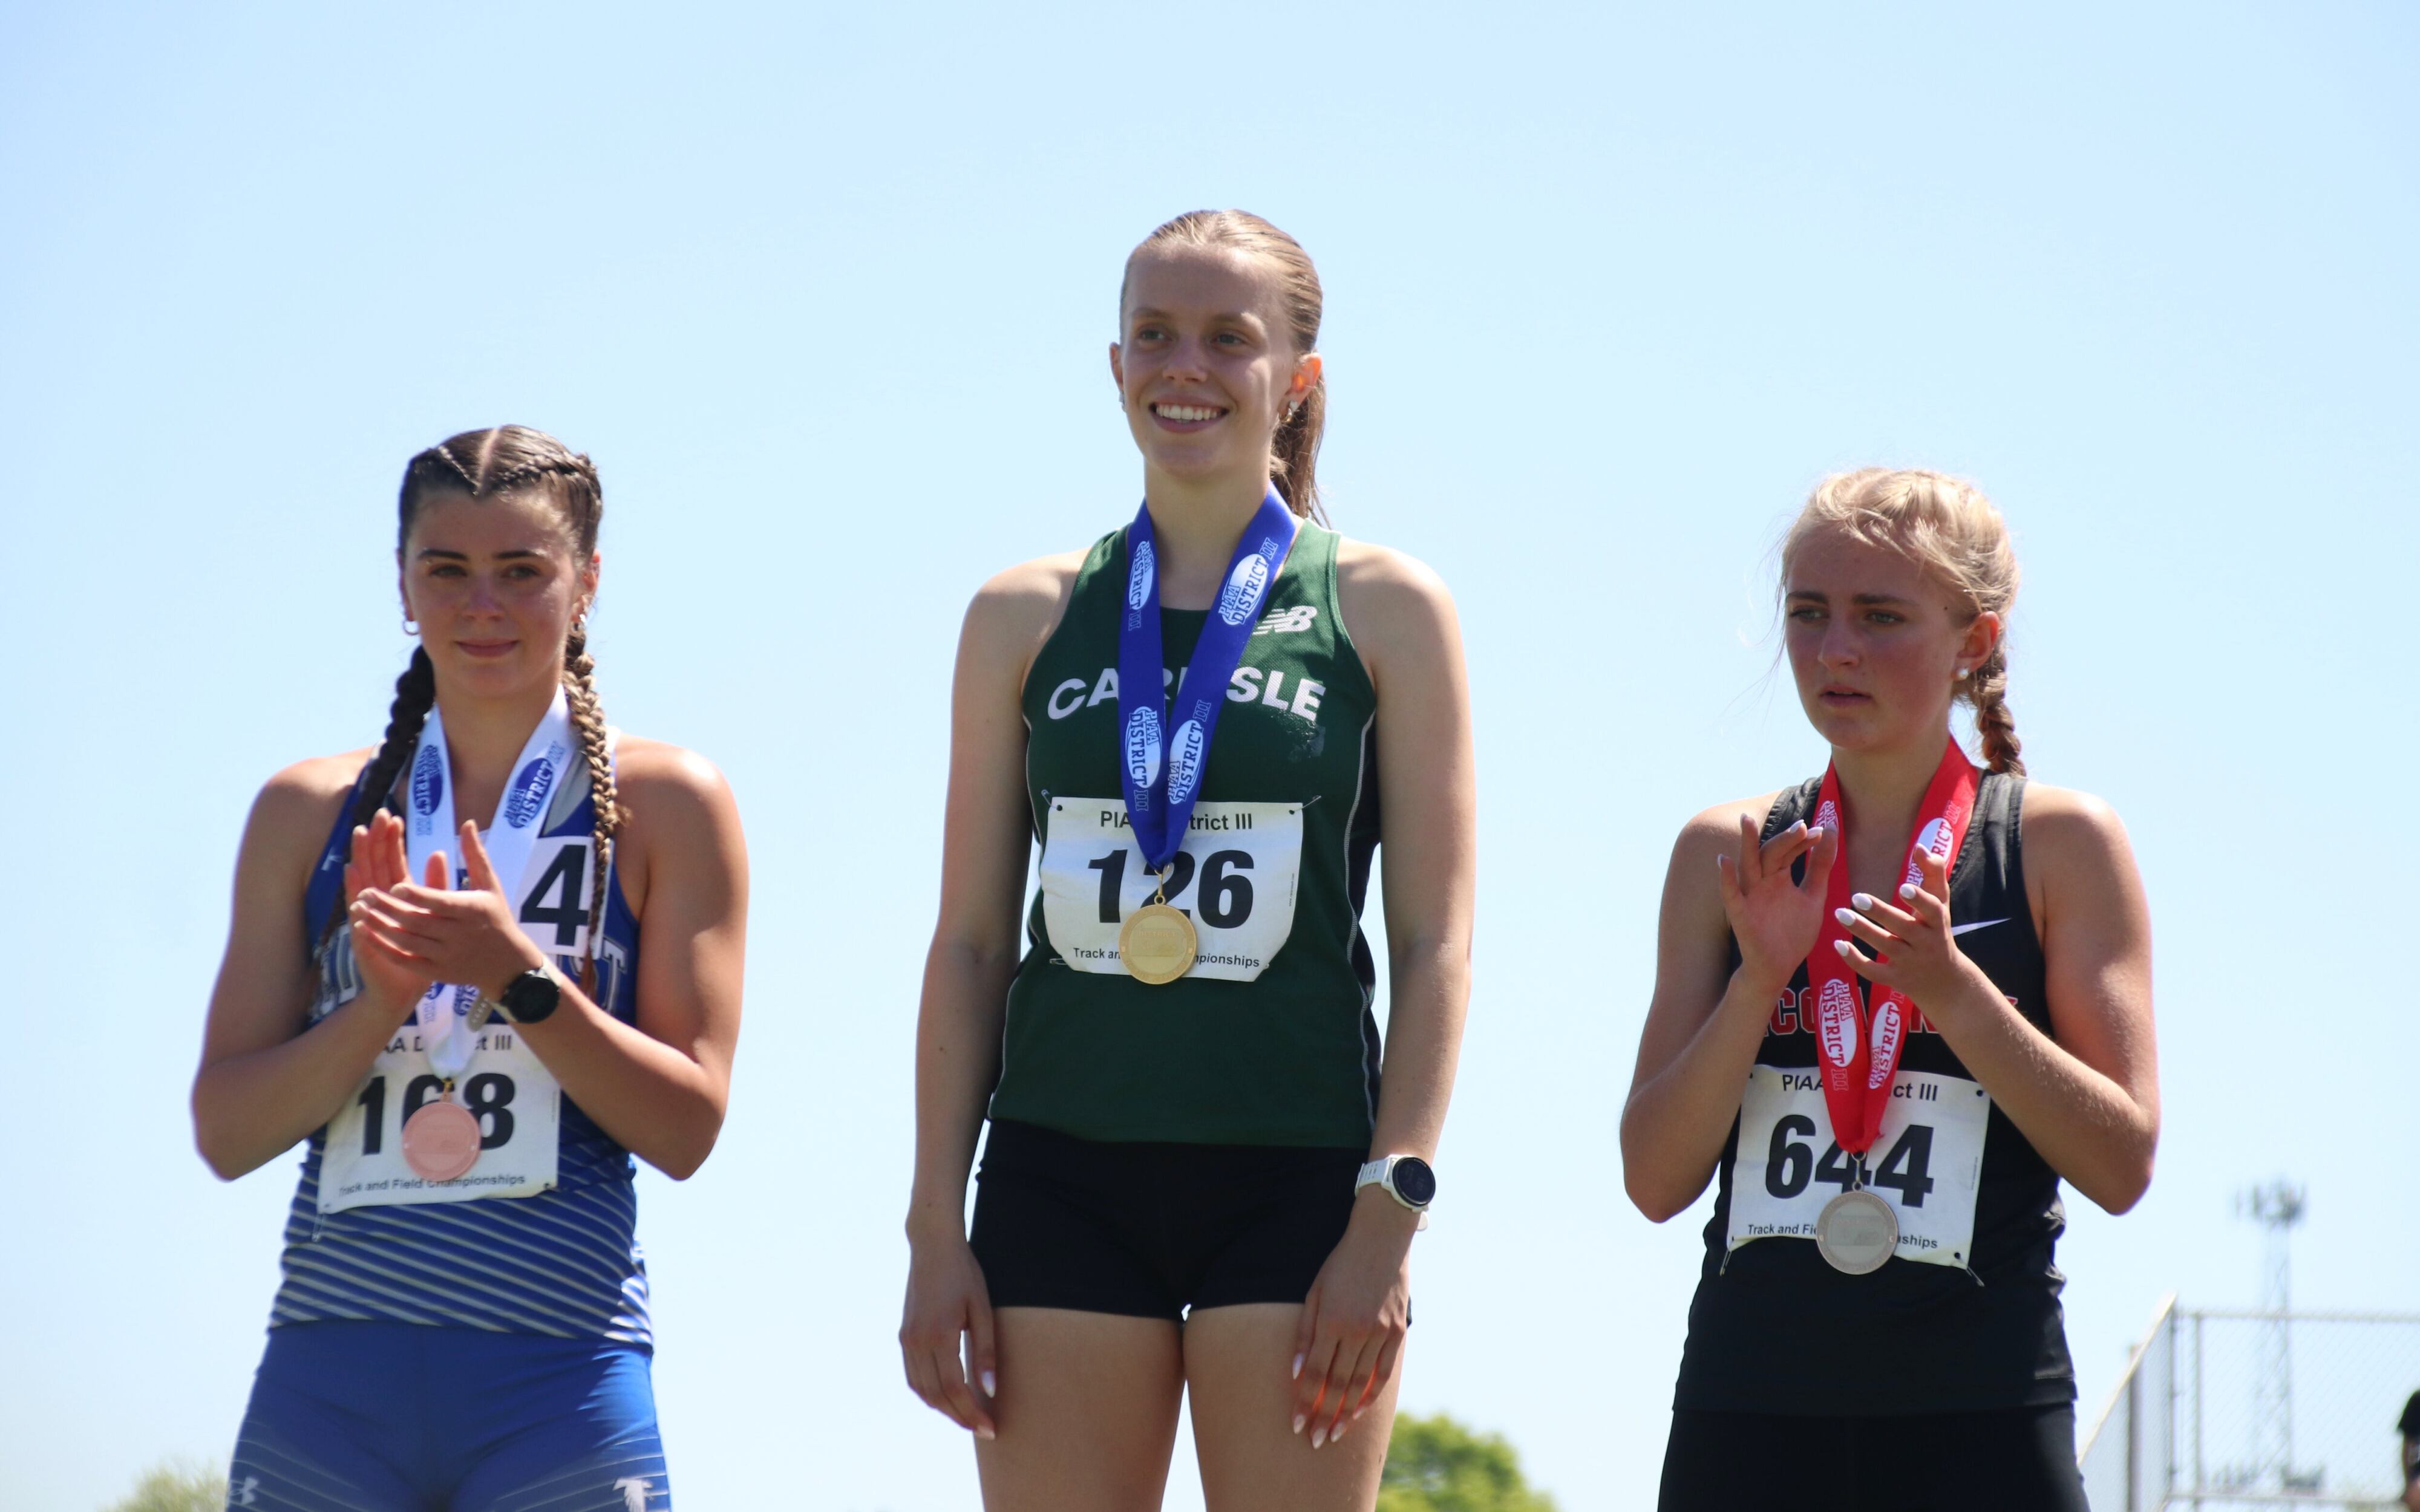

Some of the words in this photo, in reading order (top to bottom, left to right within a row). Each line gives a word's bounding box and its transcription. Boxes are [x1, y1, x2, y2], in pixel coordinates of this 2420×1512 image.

[1129, 548, 1145, 610] DISTRICT
[1218, 585, 1241, 616] PIAA
[1232, 556, 1269, 624] DISTRICT
[1259, 537, 1278, 560] III
[1047, 666, 1327, 722] CASLE
[1130, 712, 1148, 785] DISTRICT
[1145, 711, 1159, 746] PIAA
[1176, 722, 1203, 801] DISTRICT
[1192, 699, 1211, 722] III
[517, 760, 555, 826] DISTRICT
[1134, 789, 1148, 811] III
[1100, 810, 1133, 828] PIA
[1189, 813, 1229, 830] trict
[1235, 813, 1252, 830] III
[1931, 821, 1952, 856] RICT
[520, 844, 589, 947] 4
[1087, 849, 1254, 929] 126
[1073, 947, 1104, 959] Track
[1108, 950, 1120, 959] an
[1195, 953, 1260, 968] pionships
[1820, 986, 1845, 1064] DISTRICT
[1837, 983, 1854, 1022] PIAA
[495, 1034, 511, 1050] III
[1876, 1004, 1900, 1086] DISTRICT
[1919, 1083, 1938, 1101] III
[365, 1180, 387, 1190] and
[392, 1179, 422, 1190] Field
[426, 1174, 526, 1188] Championships
[1765, 1114, 1934, 1208] 644
[1748, 1224, 1774, 1234] Track
[1777, 1224, 1799, 1234] and
